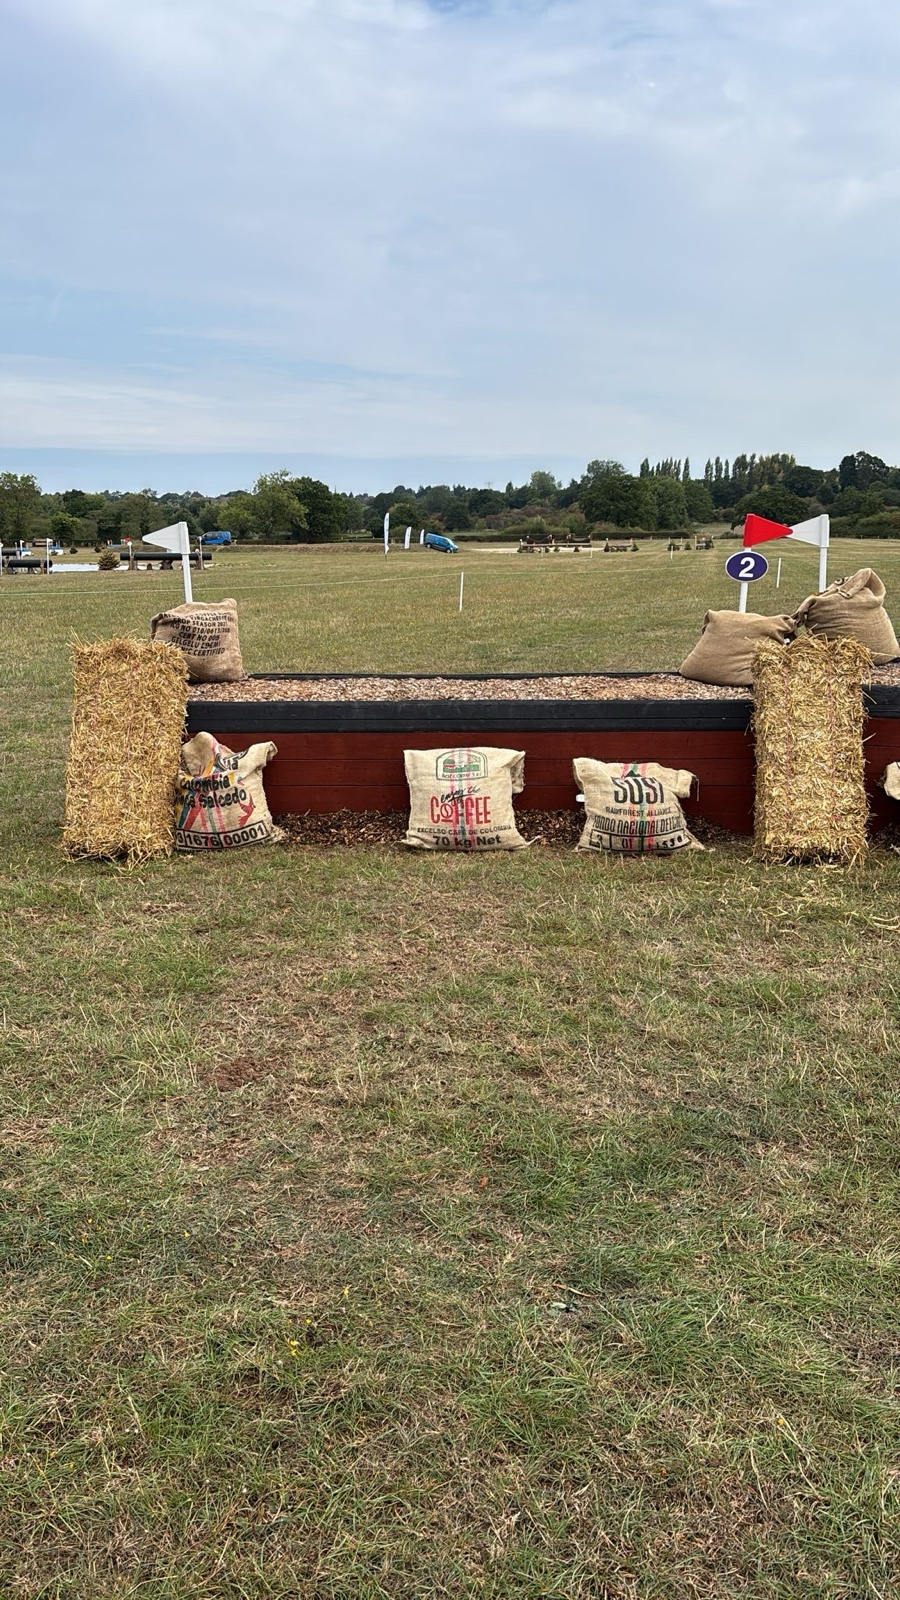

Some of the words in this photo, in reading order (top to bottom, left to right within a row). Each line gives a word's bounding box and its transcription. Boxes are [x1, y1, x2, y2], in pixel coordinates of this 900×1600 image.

[739, 557, 755, 577] 2
[193, 648, 226, 656] CERTIFIED
[180, 773, 230, 792] Colombia
[199, 786, 246, 808] Salcedo
[430, 796, 491, 824] COFFEE
[606, 807, 644, 817] RAINFOREST
[647, 807, 672, 817] ALLIANCE
[480, 825, 512, 835] COLOMBIA
[594, 815, 616, 833] FONDO
[617, 819, 658, 835] NACIONAL
[176, 832, 184, 843] 3
[186, 833, 220, 847] 1676
[223, 825, 265, 846] 00001
[433, 836, 450, 846] 70
[455, 836, 471, 848] kg
[476, 834, 502, 845] Net
